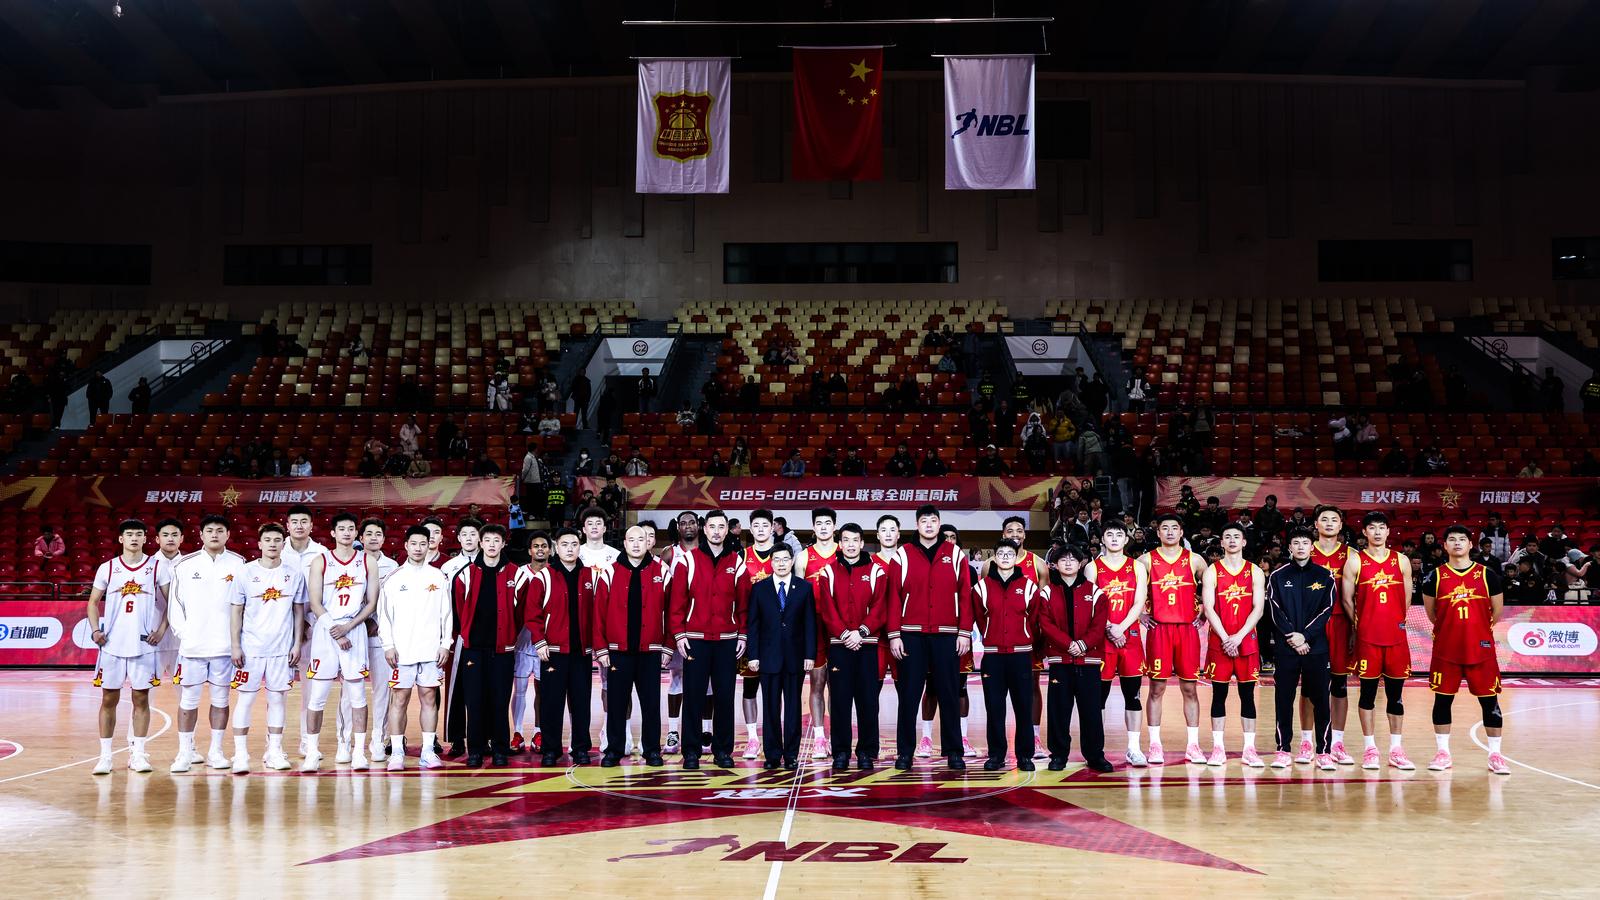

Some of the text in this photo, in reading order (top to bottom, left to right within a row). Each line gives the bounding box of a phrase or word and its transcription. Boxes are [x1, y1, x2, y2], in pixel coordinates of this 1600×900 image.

[977, 114, 1030, 136] NBL
[635, 344, 647, 352] C2
[1033, 343, 1046, 351] C3
[145, 490, 318, 503] 星火传承 闪耀遵义
[719, 489, 959, 502] 2025-2026NBL联赛全明星周末
[1360, 490, 1541, 504] 星火传承 闪耀遵义
[338, 593, 350, 606] 17
[1168, 593, 1176, 605] 9
[1379, 591, 1387, 604] 9
[125, 600, 134, 613] 6
[1110, 598, 1124, 612] 77
[1232, 603, 1239, 615] 7
[1457, 606, 1469, 619] 11
[9, 626, 49, 640] 直播吧
[1548, 630, 1580, 644] 微博
[1154, 658, 1161, 671] 9
[1360, 659, 1367, 671] 9
[234, 669, 250, 683] 99
[392, 668, 399, 681] 8
[1433, 671, 1442, 685] 11
[720, 841, 969, 864] NBL
